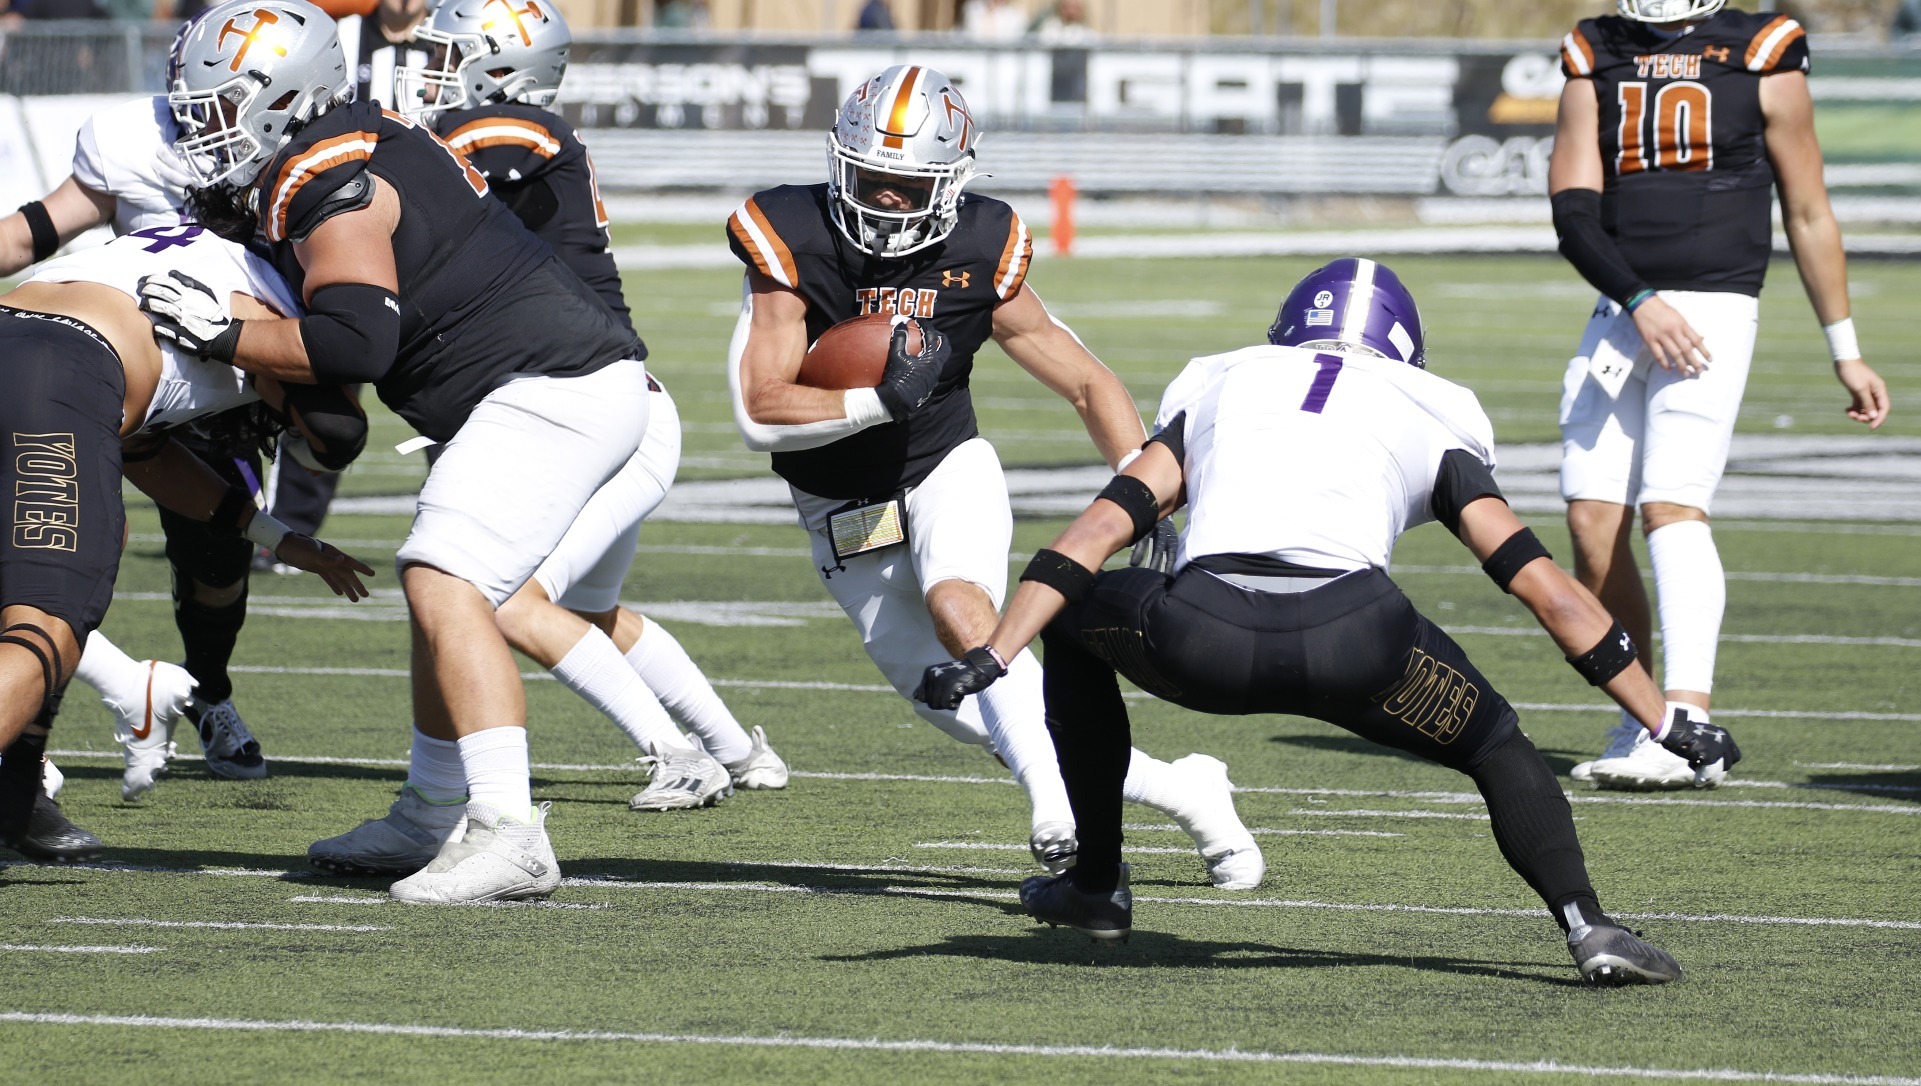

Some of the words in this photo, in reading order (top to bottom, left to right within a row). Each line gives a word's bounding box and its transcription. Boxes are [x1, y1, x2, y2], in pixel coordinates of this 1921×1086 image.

[1633, 54, 1702, 79] TECH
[1614, 81, 1714, 176] 10
[876, 149, 905, 160] FAMILY
[855, 286, 938, 318] TECH
[1316, 293, 1331, 301] JR
[1299, 352, 1344, 415] 1
[12, 432, 79, 553] YOTES
